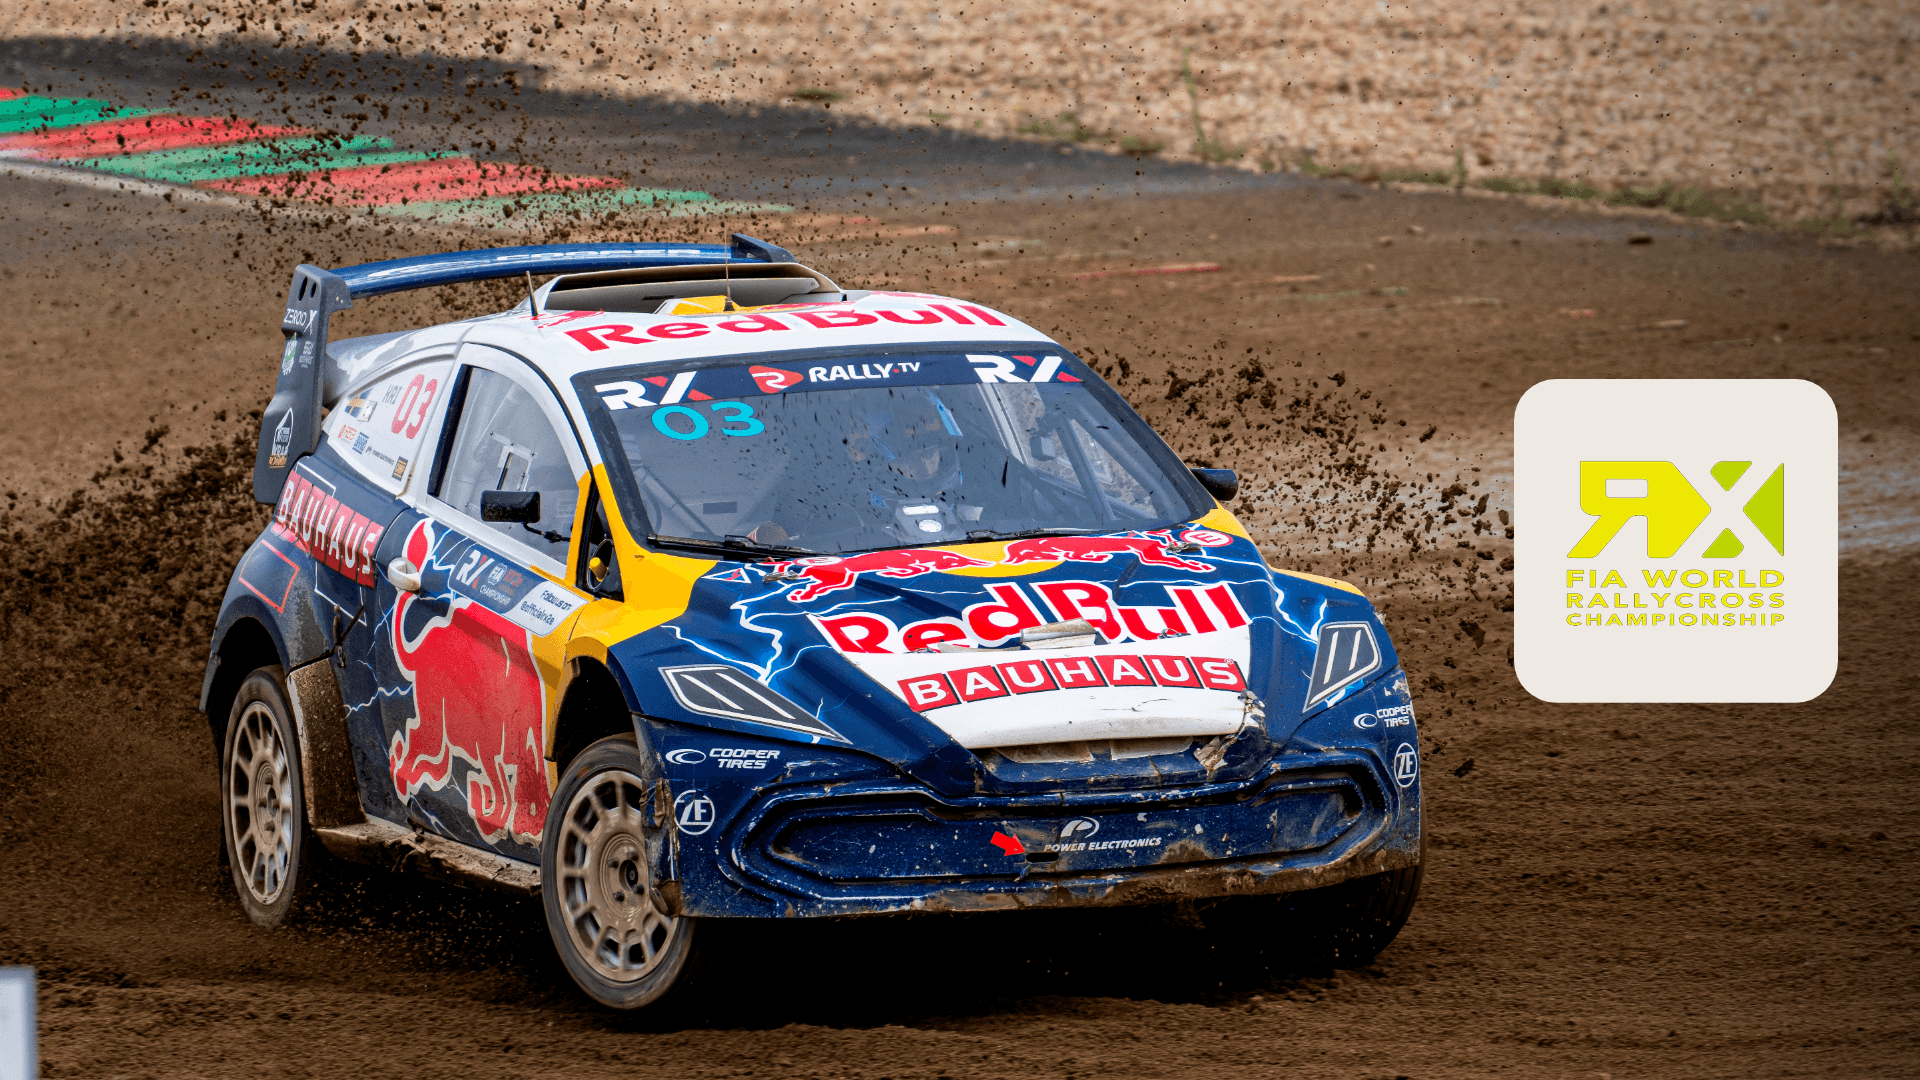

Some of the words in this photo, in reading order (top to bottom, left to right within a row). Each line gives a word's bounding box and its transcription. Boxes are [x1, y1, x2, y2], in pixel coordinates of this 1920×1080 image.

[563, 312, 791, 352] Red
[788, 303, 1007, 329] Bull
[966, 354, 1083, 382] RX
[391, 373, 437, 440] 03
[594, 371, 714, 411] RX
[651, 401, 765, 440] 03
[278, 480, 376, 574] BAUHAUS
[456, 549, 495, 589] RX
[820, 582, 1045, 654] Red
[1038, 580, 1248, 642] Bull
[912, 658, 1238, 705] BAUHAUS
[1384, 716, 1410, 728] TIRES
[709, 748, 781, 759] COOPER
[717, 759, 767, 769] TIRES
[1043, 842, 1086, 852] POWER
[1088, 837, 1162, 850] ELECTRONICS
